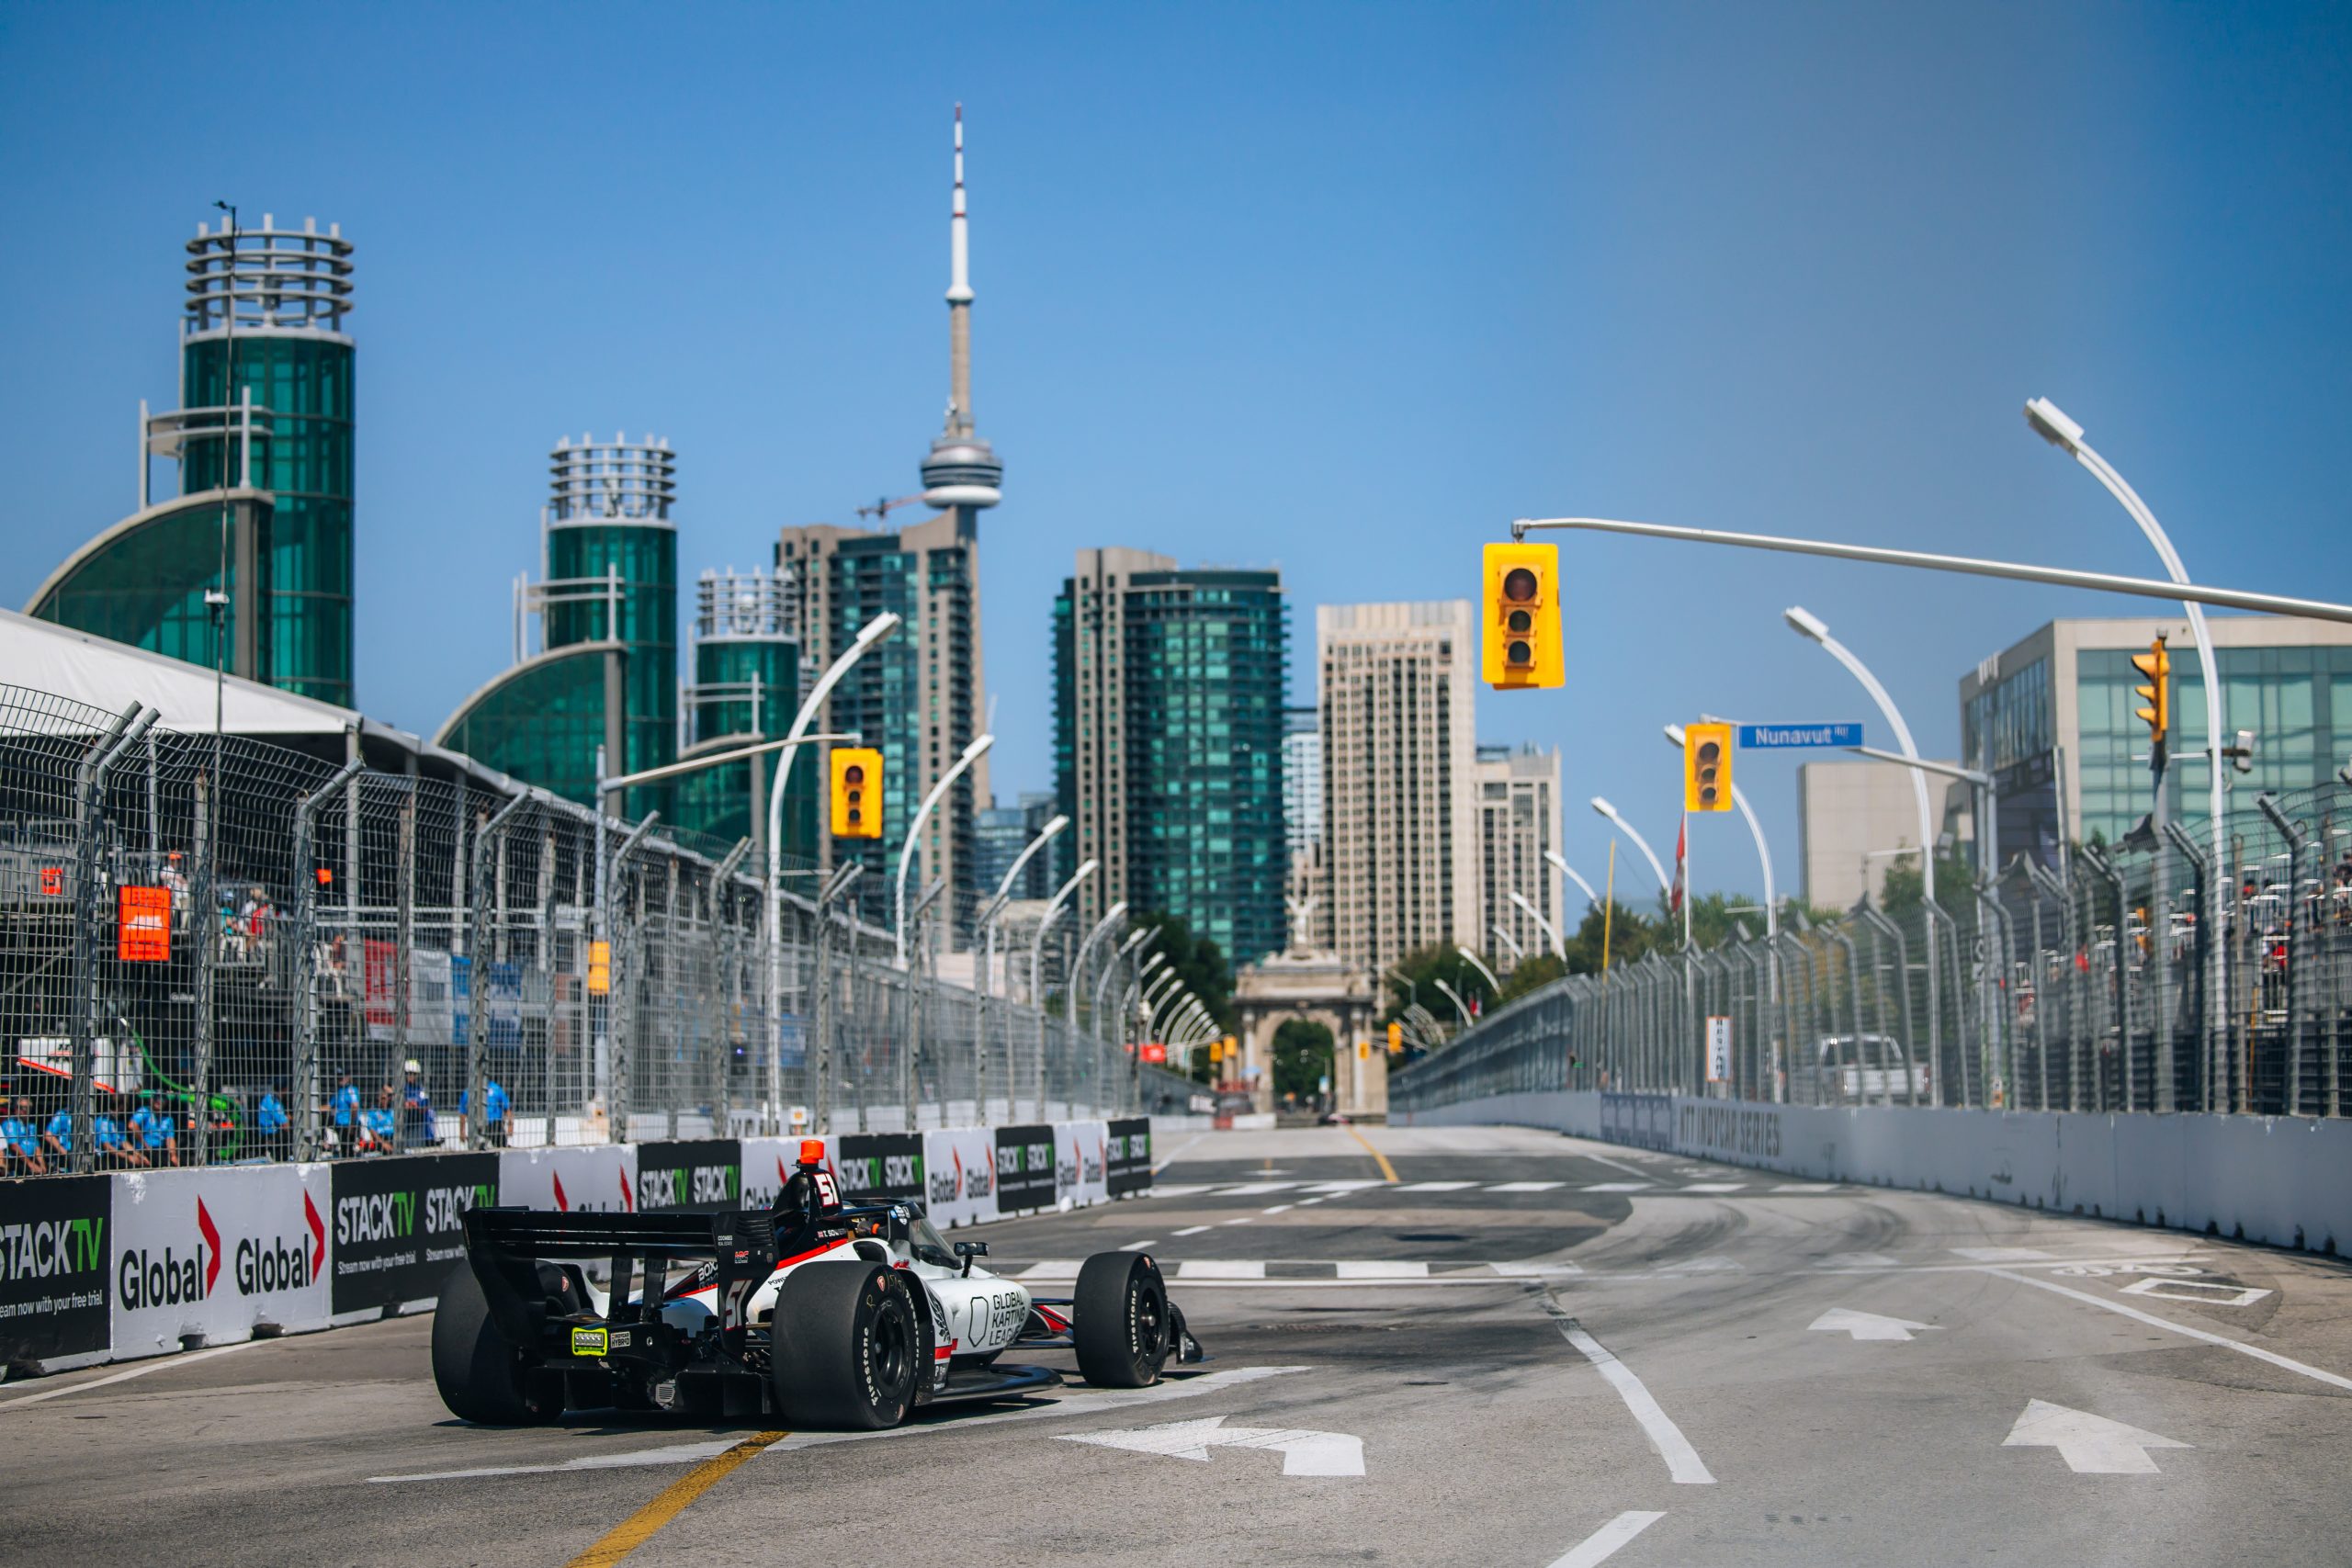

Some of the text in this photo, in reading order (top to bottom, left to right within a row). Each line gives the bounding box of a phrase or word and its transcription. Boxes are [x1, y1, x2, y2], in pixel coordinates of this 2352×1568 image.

[1755, 728, 1833, 745] Nunavut
[1679, 1105, 1781, 1156] NTT INDYCAR SERIES
[640, 1168, 688, 1210] STACKTV
[694, 1165, 739, 1204] STACKTV
[839, 1157, 881, 1192] STACKTV
[886, 1155, 923, 1188] STACKTV
[813, 1173, 840, 1207] 51
[337, 1190, 415, 1246] STACKTV
[120, 1244, 203, 1311] Global
[236, 1233, 310, 1296] Global
[338, 1260, 358, 1275] Stream
[359, 1260, 370, 1271] now
[371, 1256, 382, 1270] with
[18, 1301, 34, 1316] now
[36, 1295, 53, 1313] with
[53, 1296, 71, 1315] your
[72, 1292, 87, 1308] free
[87, 1289, 103, 1306] trial
[992, 1291, 1023, 1310] GLOBAL
[992, 1306, 1025, 1328] KARTING
[989, 1325, 1021, 1346] LEAGUE
[1130, 1290, 1139, 1353] Firestone
[863, 1326, 877, 1406] Firestone
